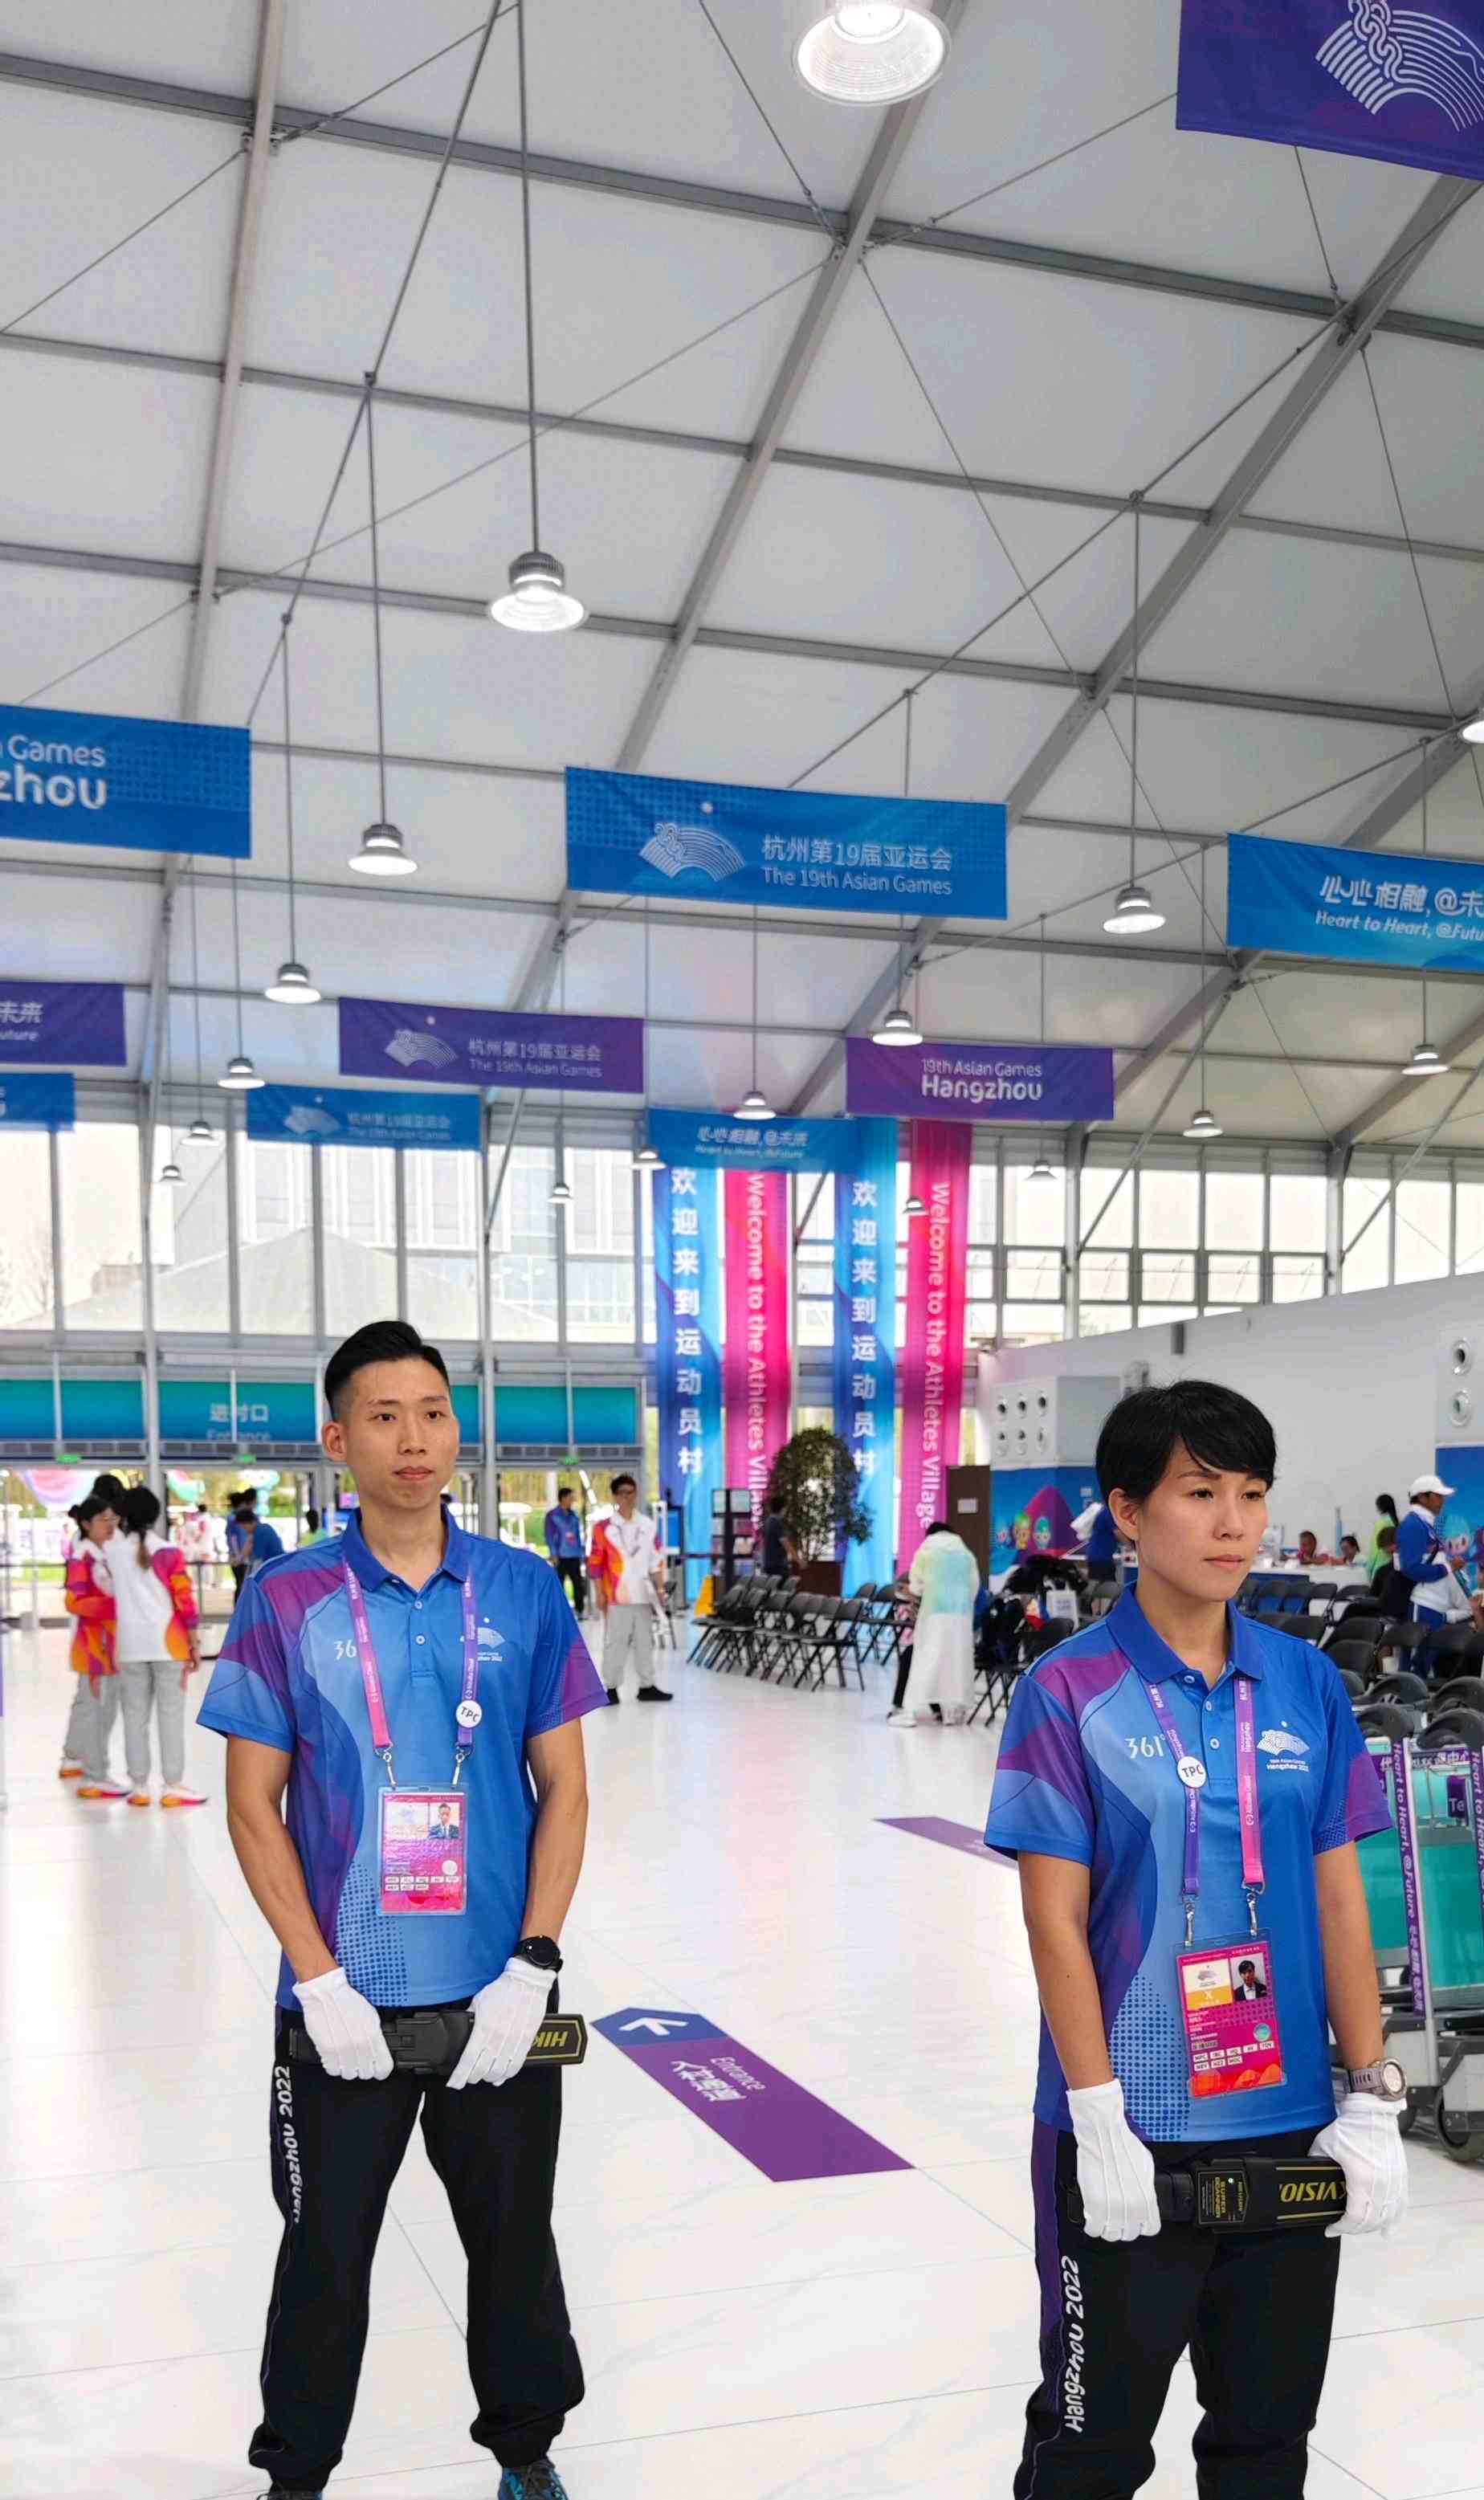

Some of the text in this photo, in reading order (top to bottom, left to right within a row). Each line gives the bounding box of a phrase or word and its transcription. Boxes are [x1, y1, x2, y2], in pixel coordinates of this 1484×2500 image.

[8, 733, 106, 768] Games
[762, 834, 952, 871] 杭州第19届亚运会
[763, 867, 953, 895] The 19th Asian Games
[1315, 909, 1360, 930] Heart
[1365, 916, 1381, 932] to
[1384, 917, 1432, 939] Heart,
[470, 1058, 494, 1071] The
[526, 1062, 558, 1075] Asian
[922, 1058, 1042, 1078] 19th Asian Games
[922, 1074, 1042, 1103] Hangzhou
[747, 1174, 768, 1282] Welcome
[747, 1285, 766, 1310] to
[671, 1168, 704, 1475] 欢迎来到运动员村
[748, 1314, 768, 1353] the
[915, 1181, 952, 1529] Welcome to the Athletes Village
[747, 1356, 768, 1452] Athletes
[1181, 1764, 1205, 1779] TPC
[1471, 1752, 1482, 1794] Heart
[1474, 1798, 1484, 1815] to
[1392, 1742, 1416, 1919] Heart to Heart, @Future
[274, 2066, 293, 2119] 2022
[1061, 2254, 1086, 2434] Hangzhou 2022
